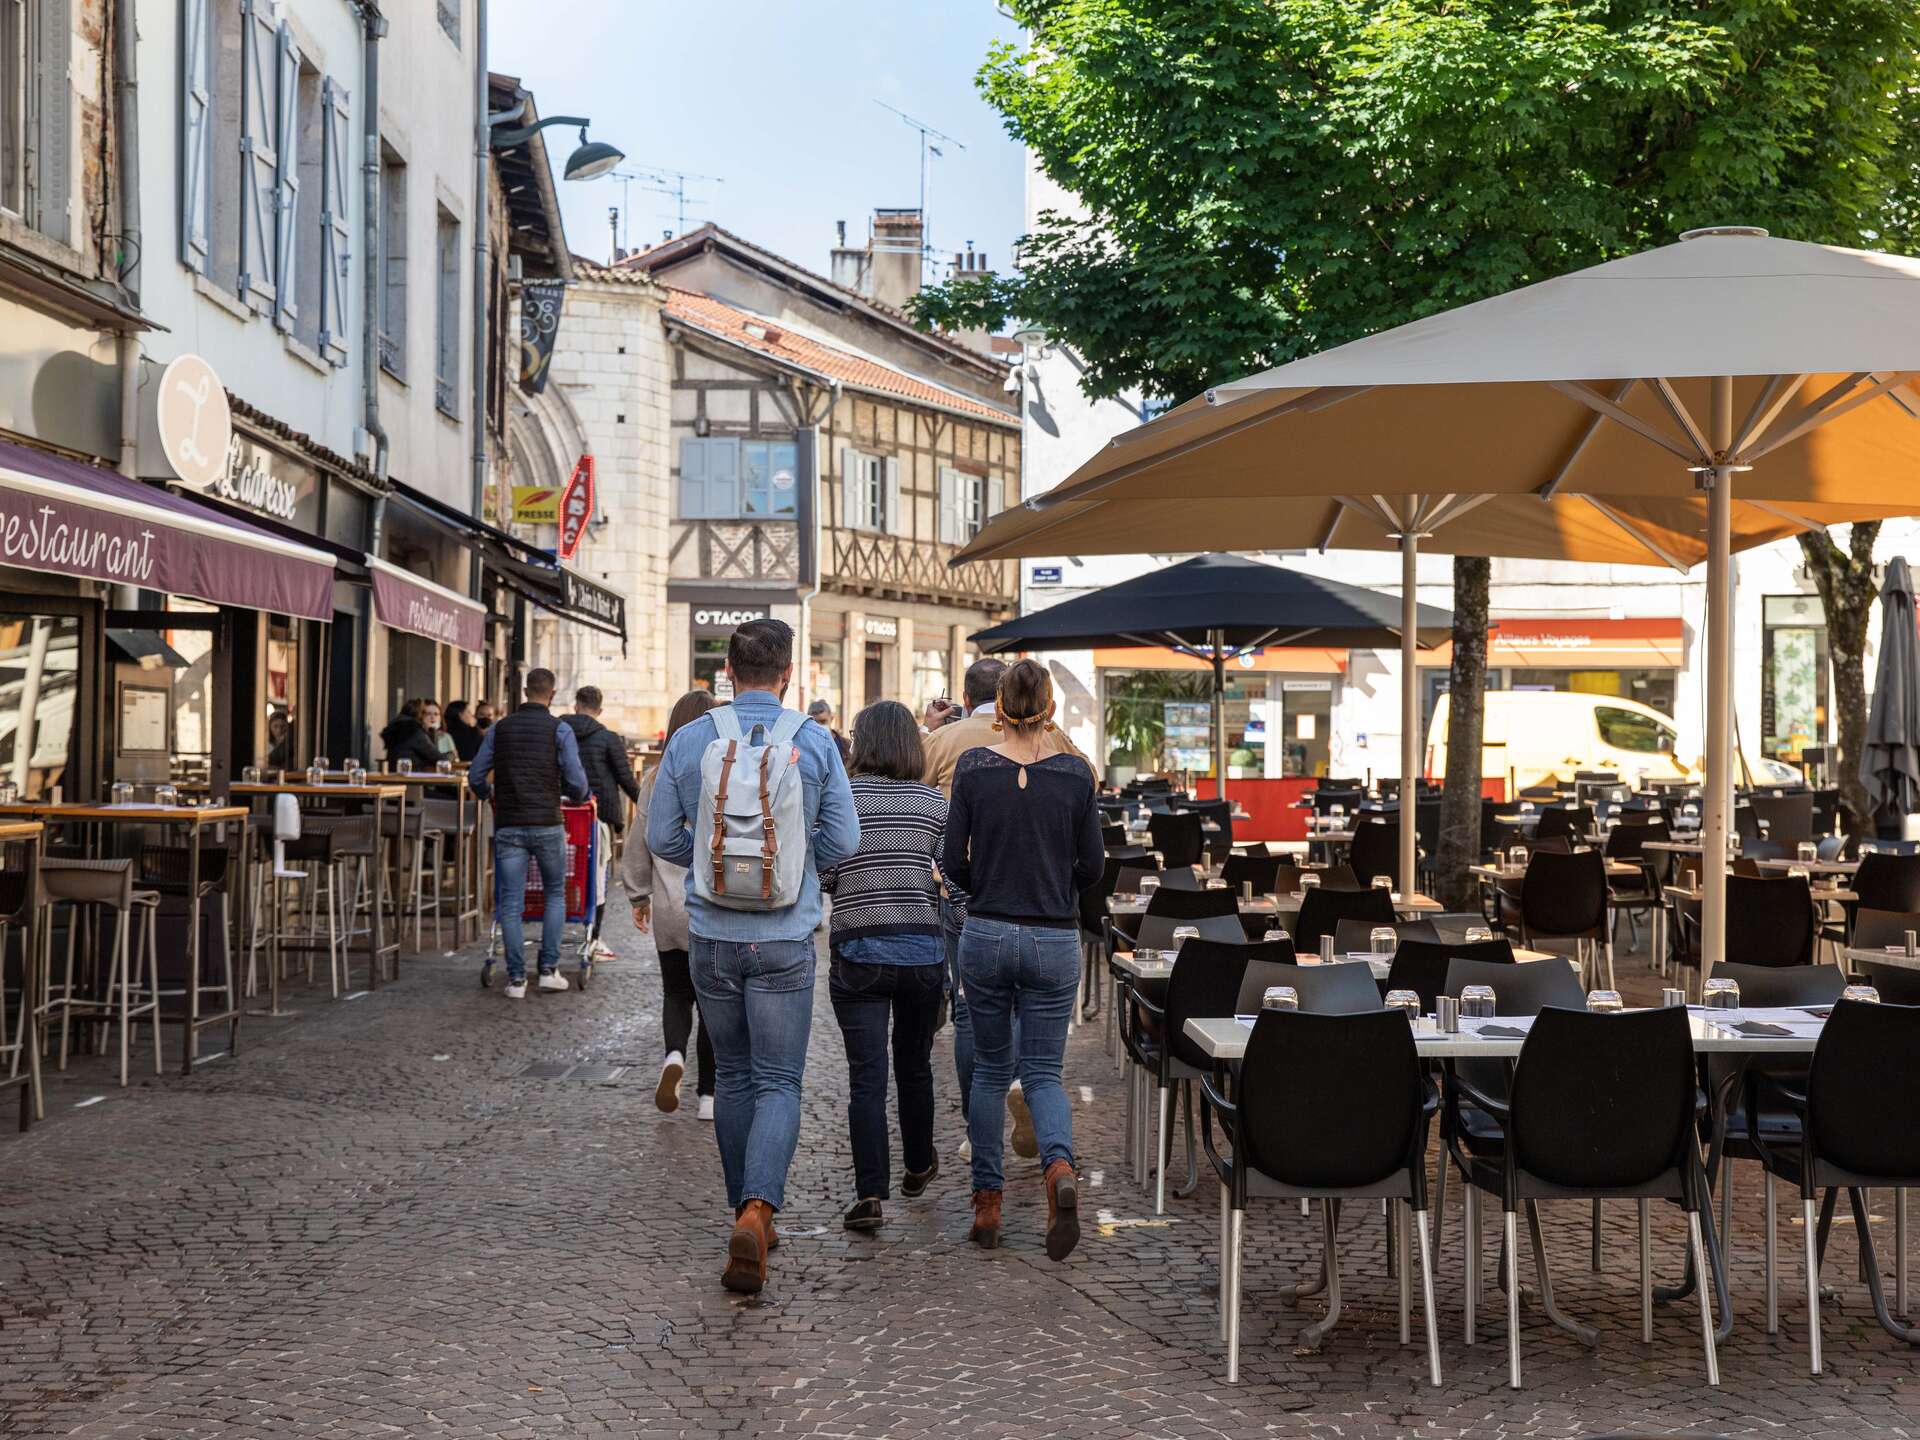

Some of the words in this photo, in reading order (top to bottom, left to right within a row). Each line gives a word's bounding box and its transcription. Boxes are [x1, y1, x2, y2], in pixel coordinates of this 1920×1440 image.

[517, 509, 555, 519] PRESSE
[564, 470, 588, 544] TABAC
[408, 596, 458, 641] restaurant
